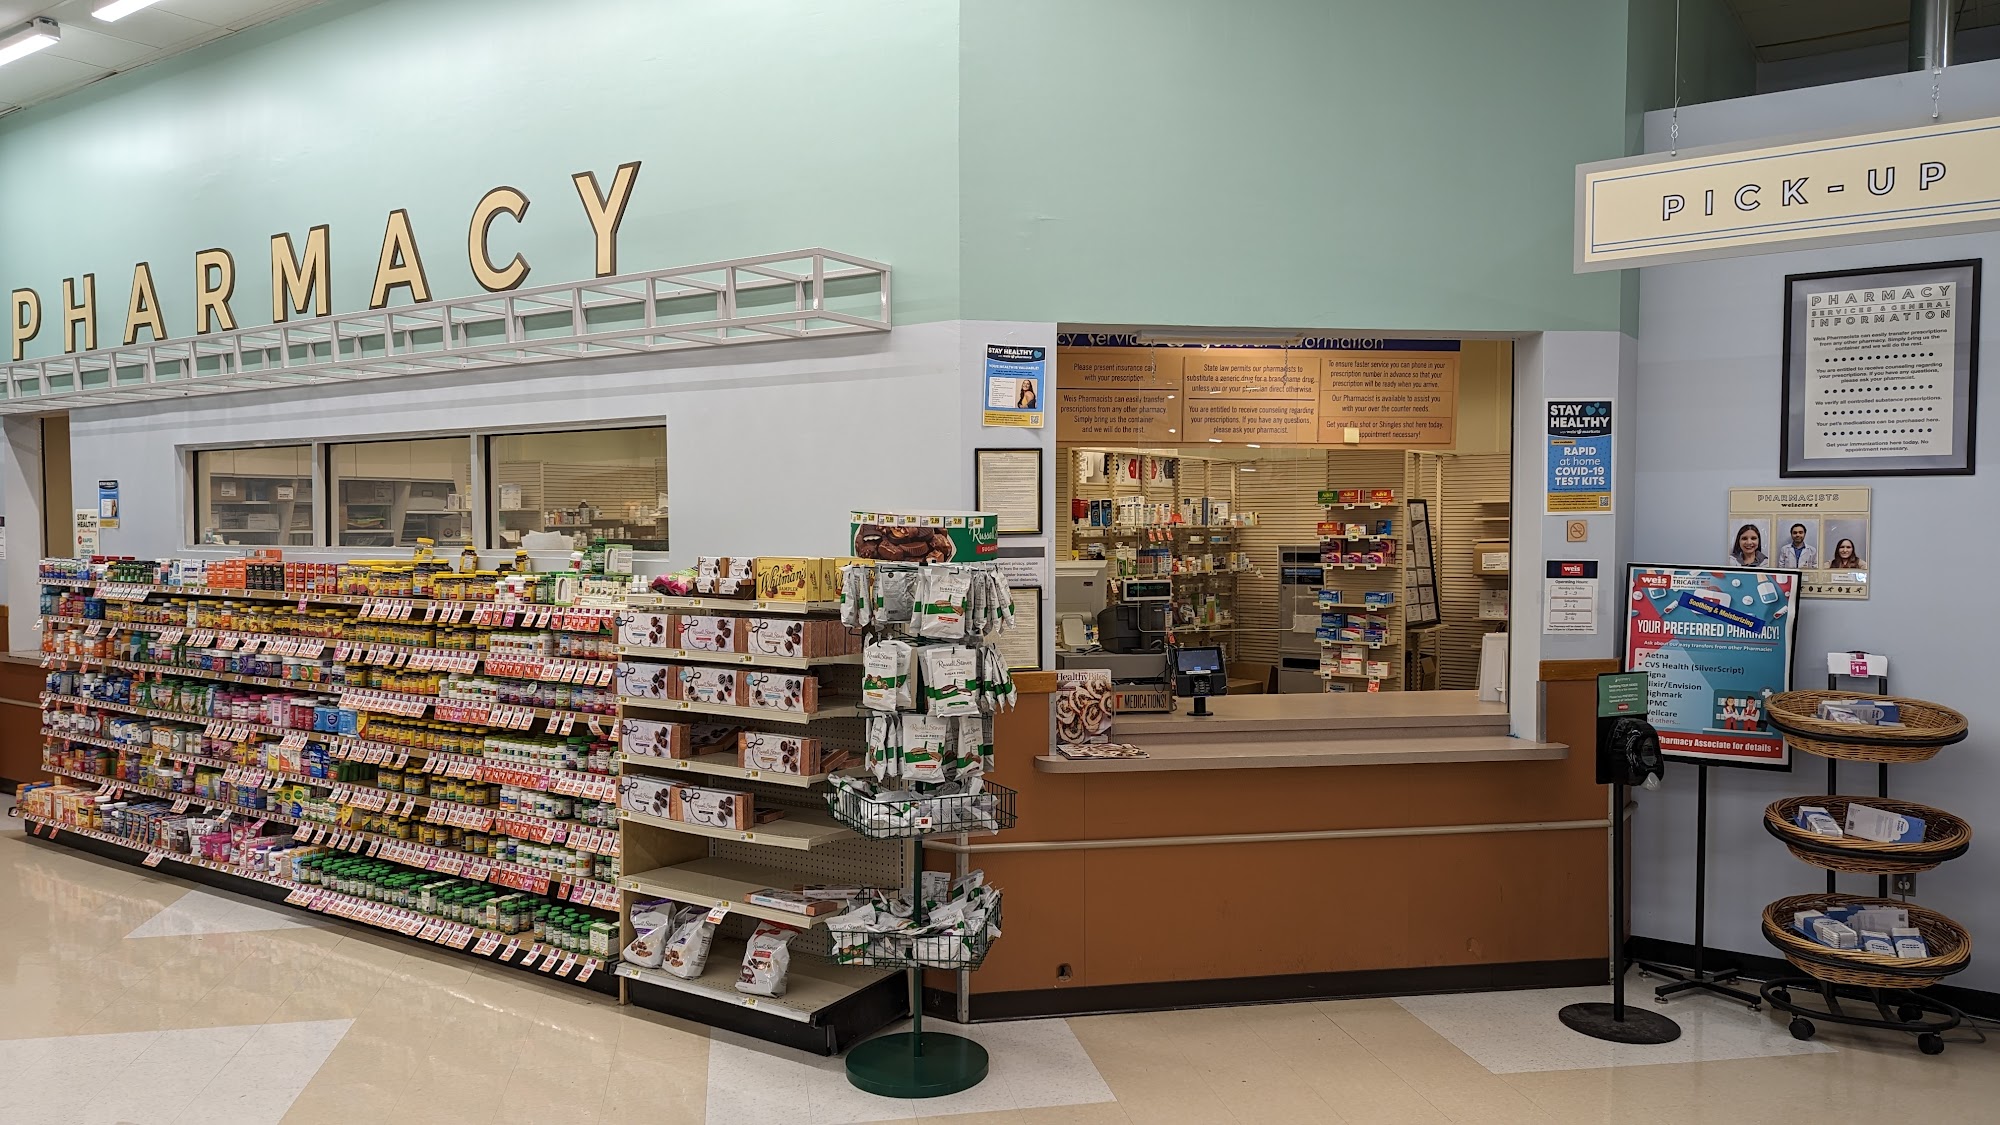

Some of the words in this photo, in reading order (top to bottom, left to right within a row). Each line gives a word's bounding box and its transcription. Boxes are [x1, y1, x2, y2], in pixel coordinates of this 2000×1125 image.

[1662, 161, 1947, 221] PICK-UP
[11, 160, 641, 362] PHARMACY
[1812, 285, 1950, 306] PHARMACY
[1812, 307, 1872, 316] SERVICES
[1891, 301, 1950, 310] GENERAL
[1811, 310, 1950, 327] INFORMATION
[1094, 364, 1114, 372] present
[1331, 370, 1360, 378] prescription
[1260, 406, 1287, 414] counseling
[1289, 407, 1314, 415] regarding
[1550, 405, 1582, 415] STAY
[1380, 421, 1401, 429] Shingles
[1551, 417, 1610, 427] HEALTHY
[1214, 426, 1231, 434] please
[1393, 431, 1420, 439] necessary!
[1564, 447, 1596, 455] RAPID
[1555, 467, 1604, 475] COVID-19
[1555, 477, 1580, 485] TEST
[1582, 477, 1604, 485] KITS
[1758, 494, 1839, 502] PHARMACISTS
[758, 565, 806, 593] Whitman's
[1642, 576, 1667, 584] weis
[1689, 598, 1713, 613] Soothing
[1719, 609, 1754, 628] Moisturizing
[1638, 620, 1660, 634] YOUR
[1664, 621, 1724, 637] PREFERRED
[1692, 664, 1745, 675] (SilverScript)
[1648, 681, 1702, 691] lixir/Envision
[1648, 690, 1682, 699] ighmark
[1125, 694, 1166, 709] MEDICATIONS!
[1694, 739, 1731, 749] Associate
[1733, 741, 1743, 750] for
[1745, 742, 1772, 752] details
